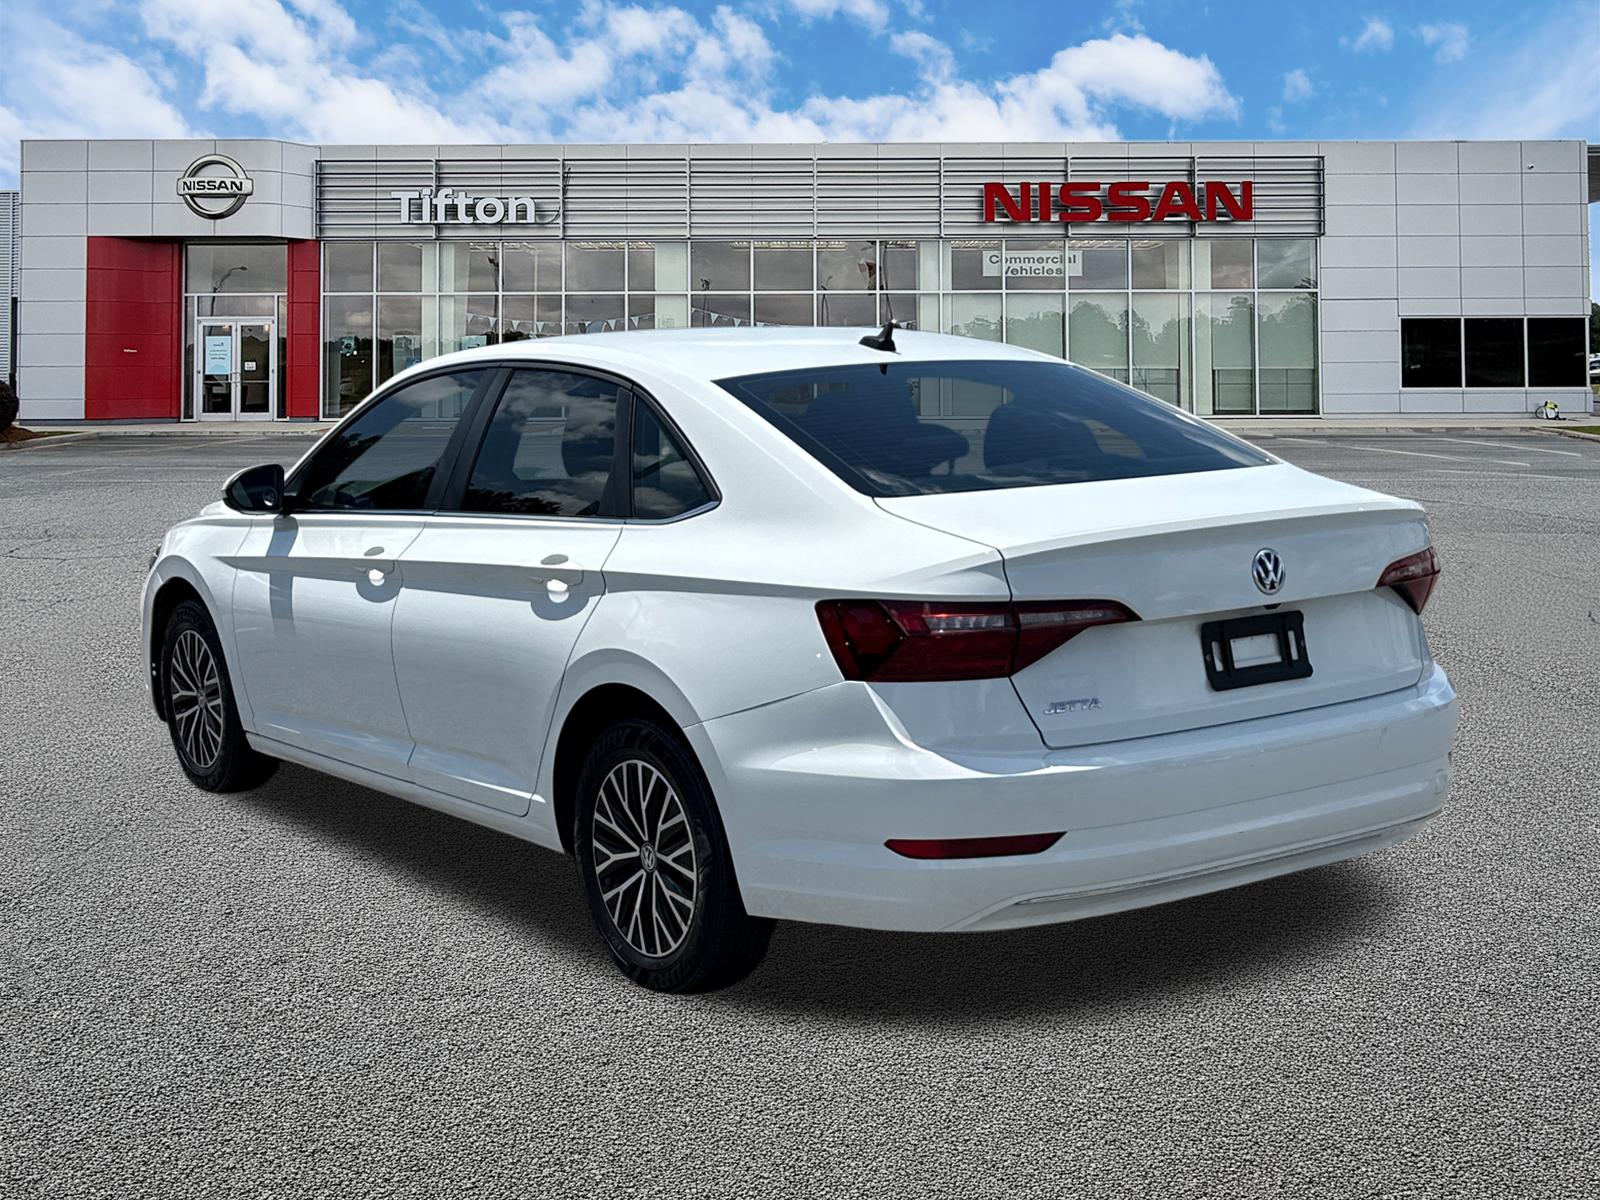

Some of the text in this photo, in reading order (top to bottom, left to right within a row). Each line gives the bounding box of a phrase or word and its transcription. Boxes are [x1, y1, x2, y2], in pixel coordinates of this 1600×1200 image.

[183, 180, 243, 191] NISSAN
[391, 188, 536, 224] Tifton
[983, 181, 1253, 222] NISSAN
[1043, 698, 1102, 715] JETTA
